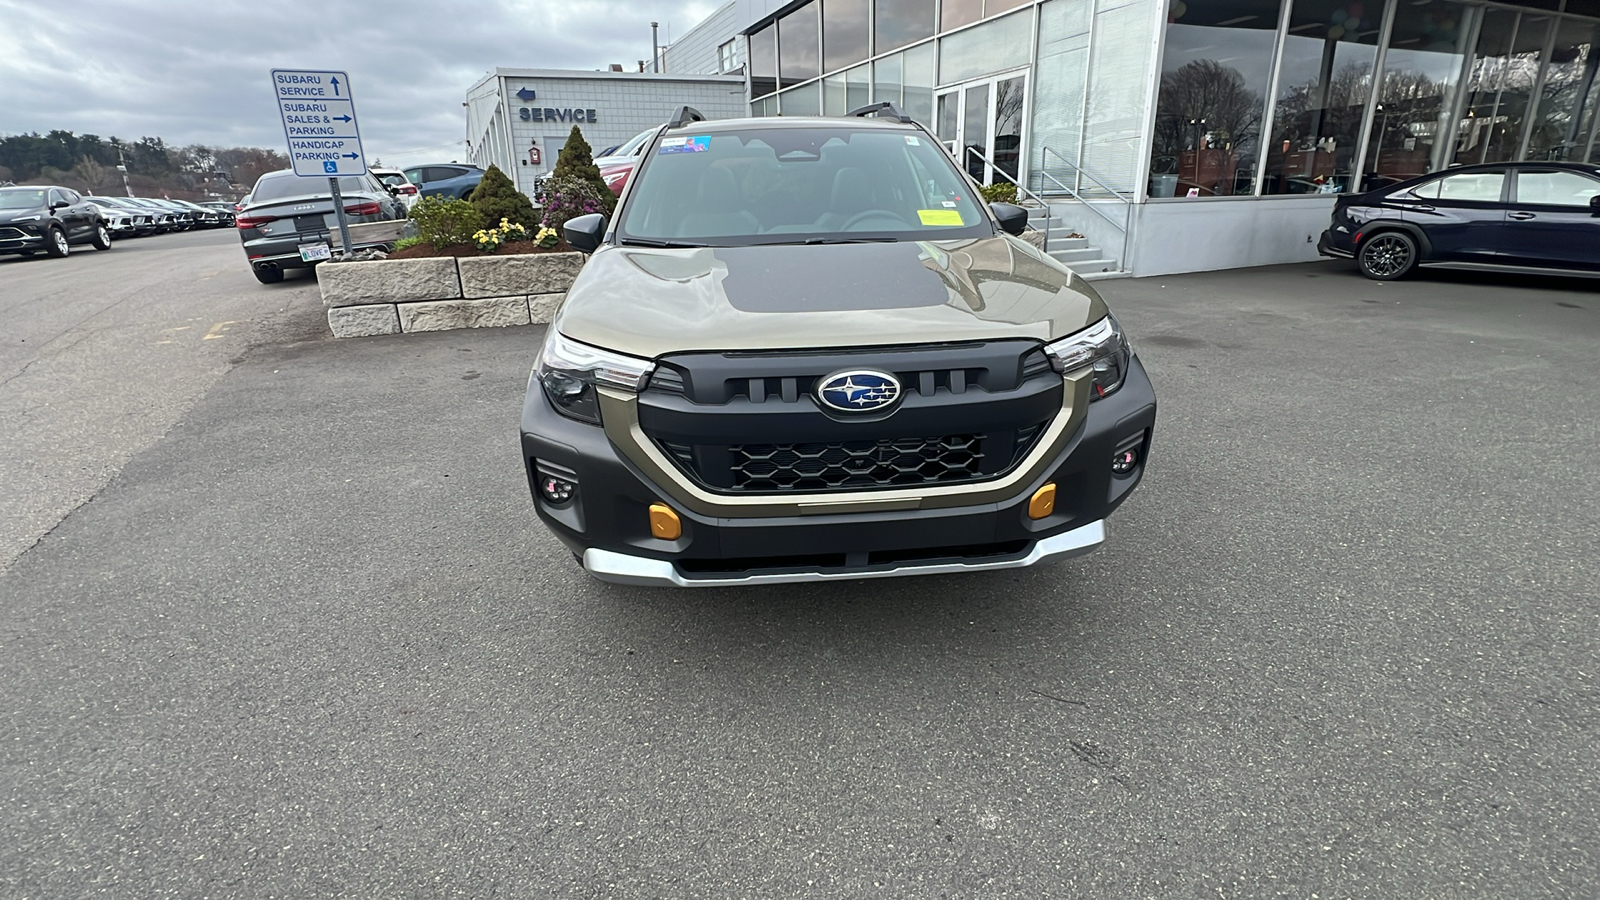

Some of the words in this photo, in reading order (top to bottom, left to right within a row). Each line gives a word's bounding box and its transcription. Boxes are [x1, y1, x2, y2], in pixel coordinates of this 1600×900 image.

[278, 75, 321, 84] SUBARU
[280, 87, 325, 96] SERVICE
[284, 104, 327, 112] SUBARU
[287, 115, 320, 123] SALES
[323, 115, 330, 123] &
[519, 107, 597, 123] SERVICE
[289, 127, 334, 135] PARKING
[292, 141, 344, 149] HANDICAP
[295, 152, 340, 160] PARKING
